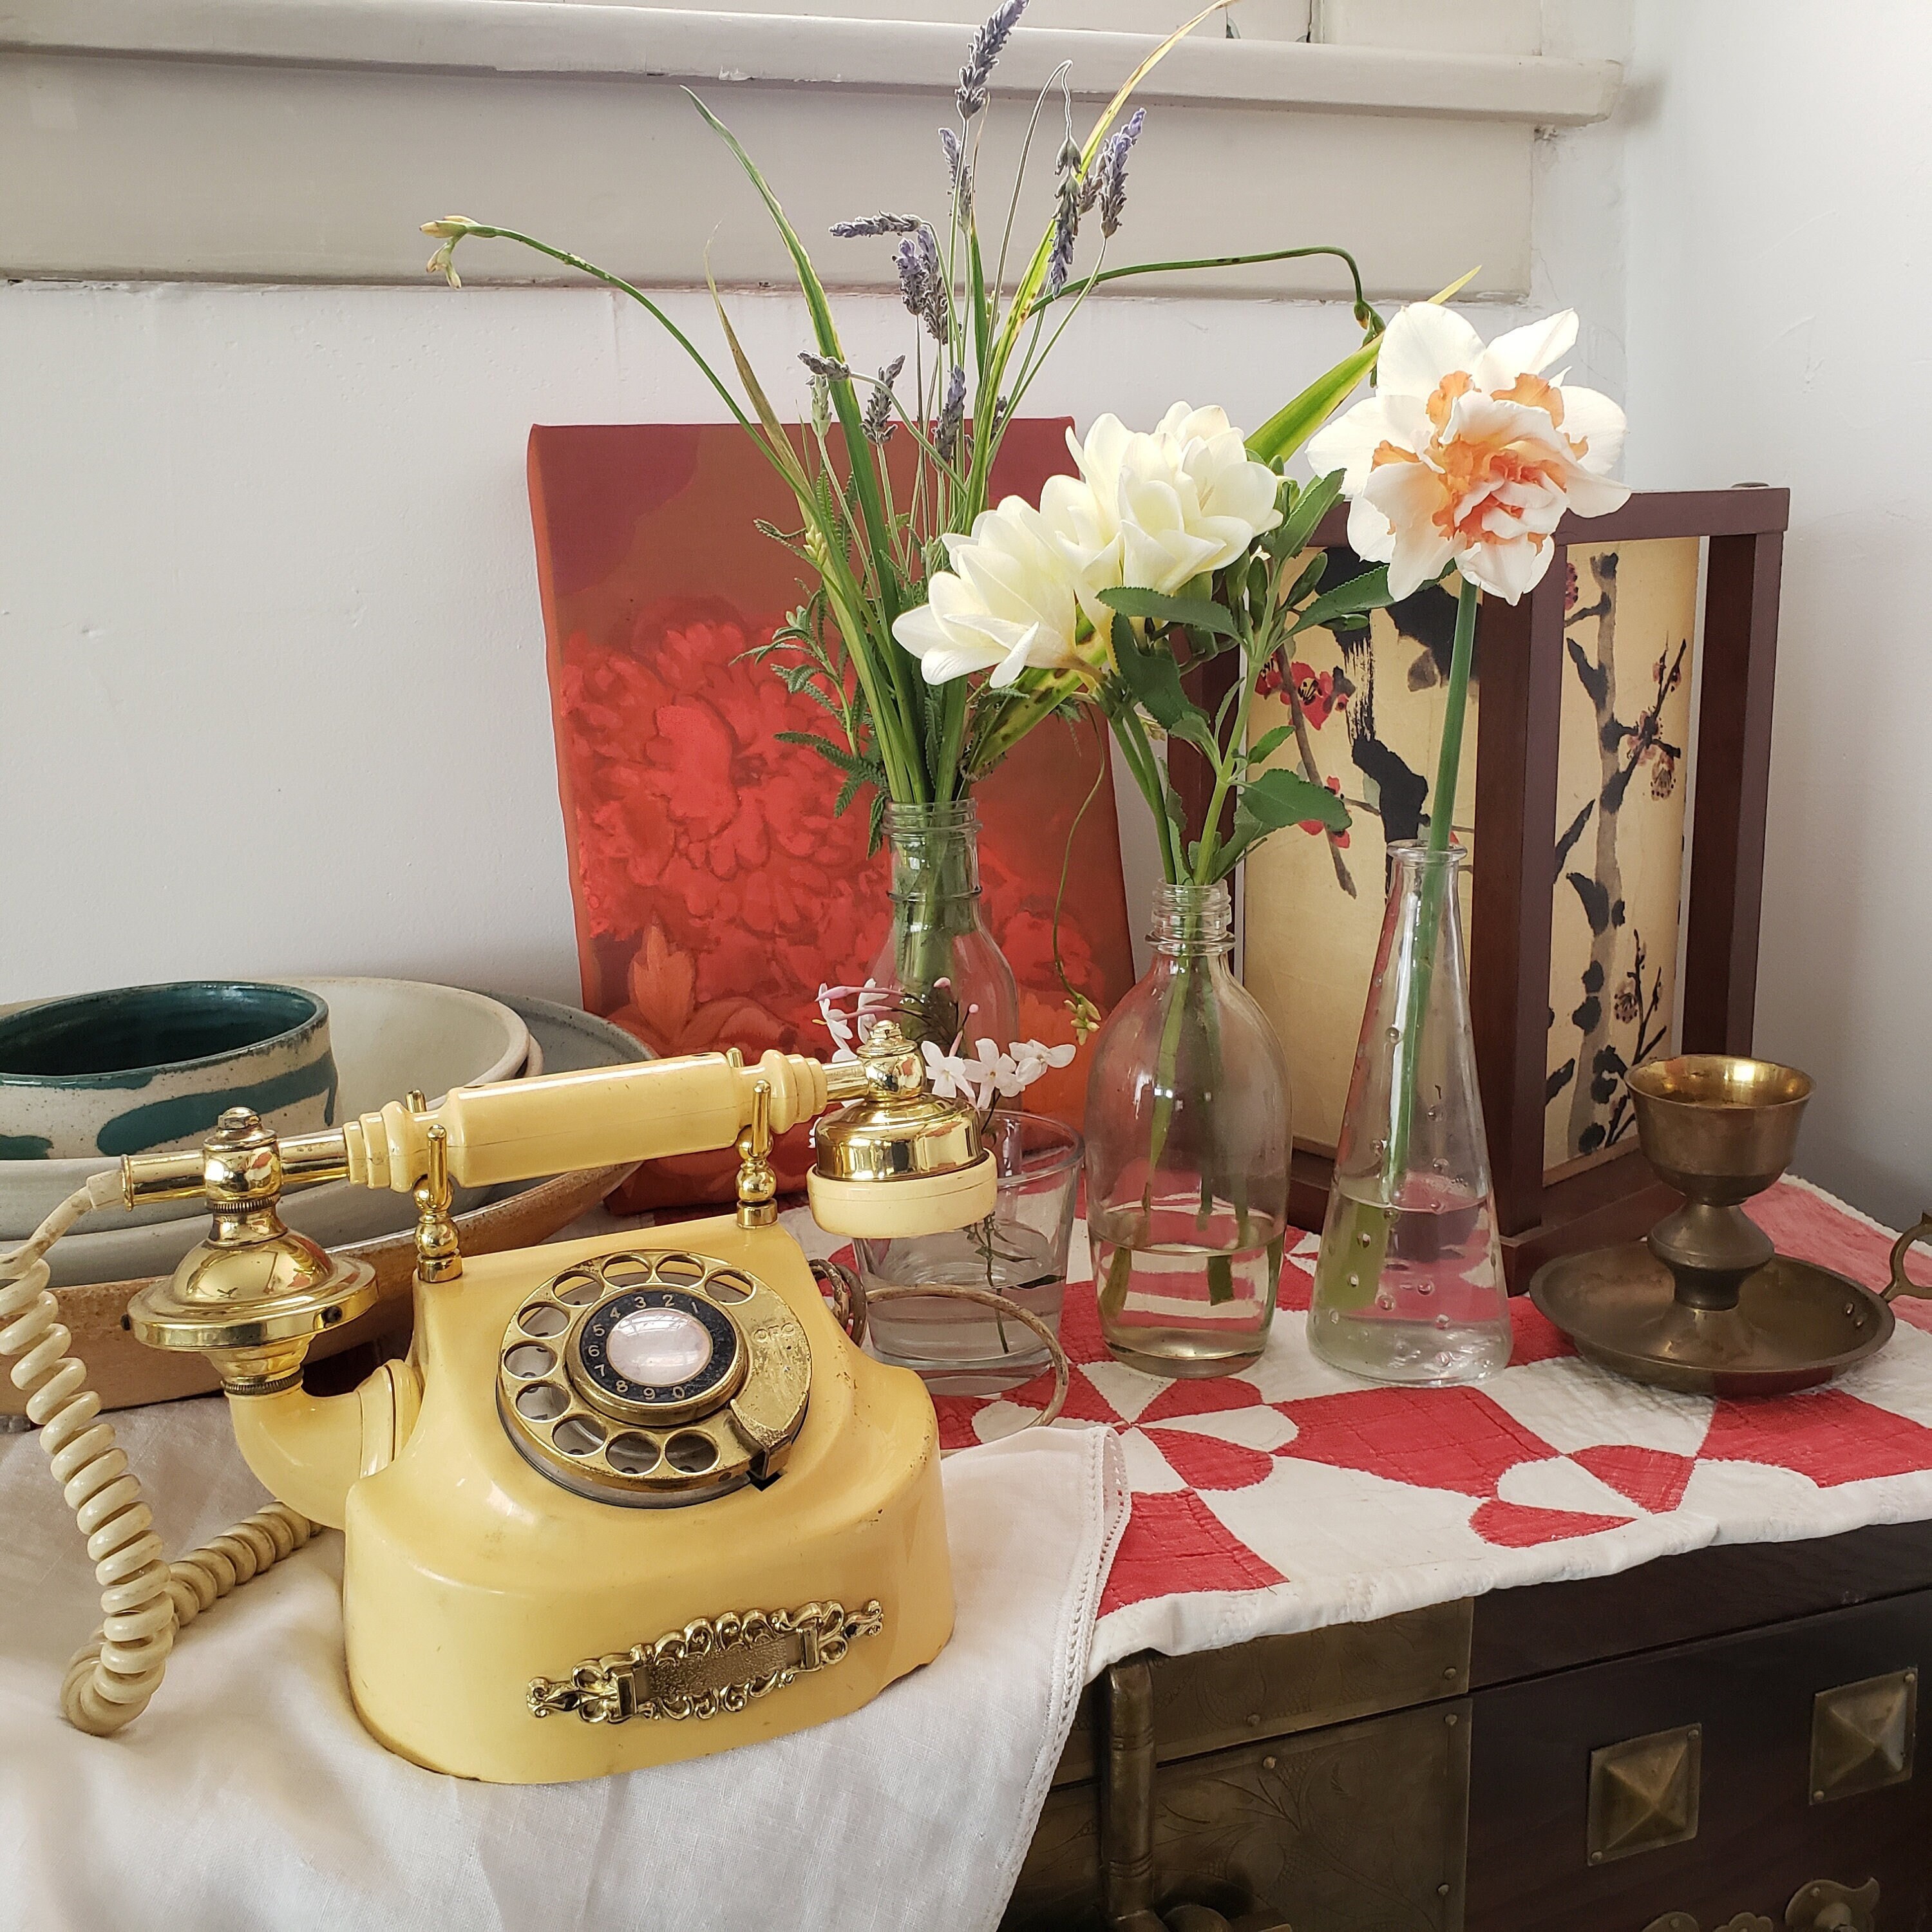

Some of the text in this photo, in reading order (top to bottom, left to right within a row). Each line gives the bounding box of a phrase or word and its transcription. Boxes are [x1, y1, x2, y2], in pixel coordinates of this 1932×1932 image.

[634, 1296, 647, 1309] 3
[662, 1294, 676, 1307] 2
[610, 1307, 621, 1319] 4
[691, 1302, 699, 1313] 1
[592, 1325, 605, 1337] 5
[588, 1345, 600, 1357] 6
[594, 1364, 605, 1378] 7
[616, 1380, 629, 1393] 8
[643, 1387, 656, 1399] 9
